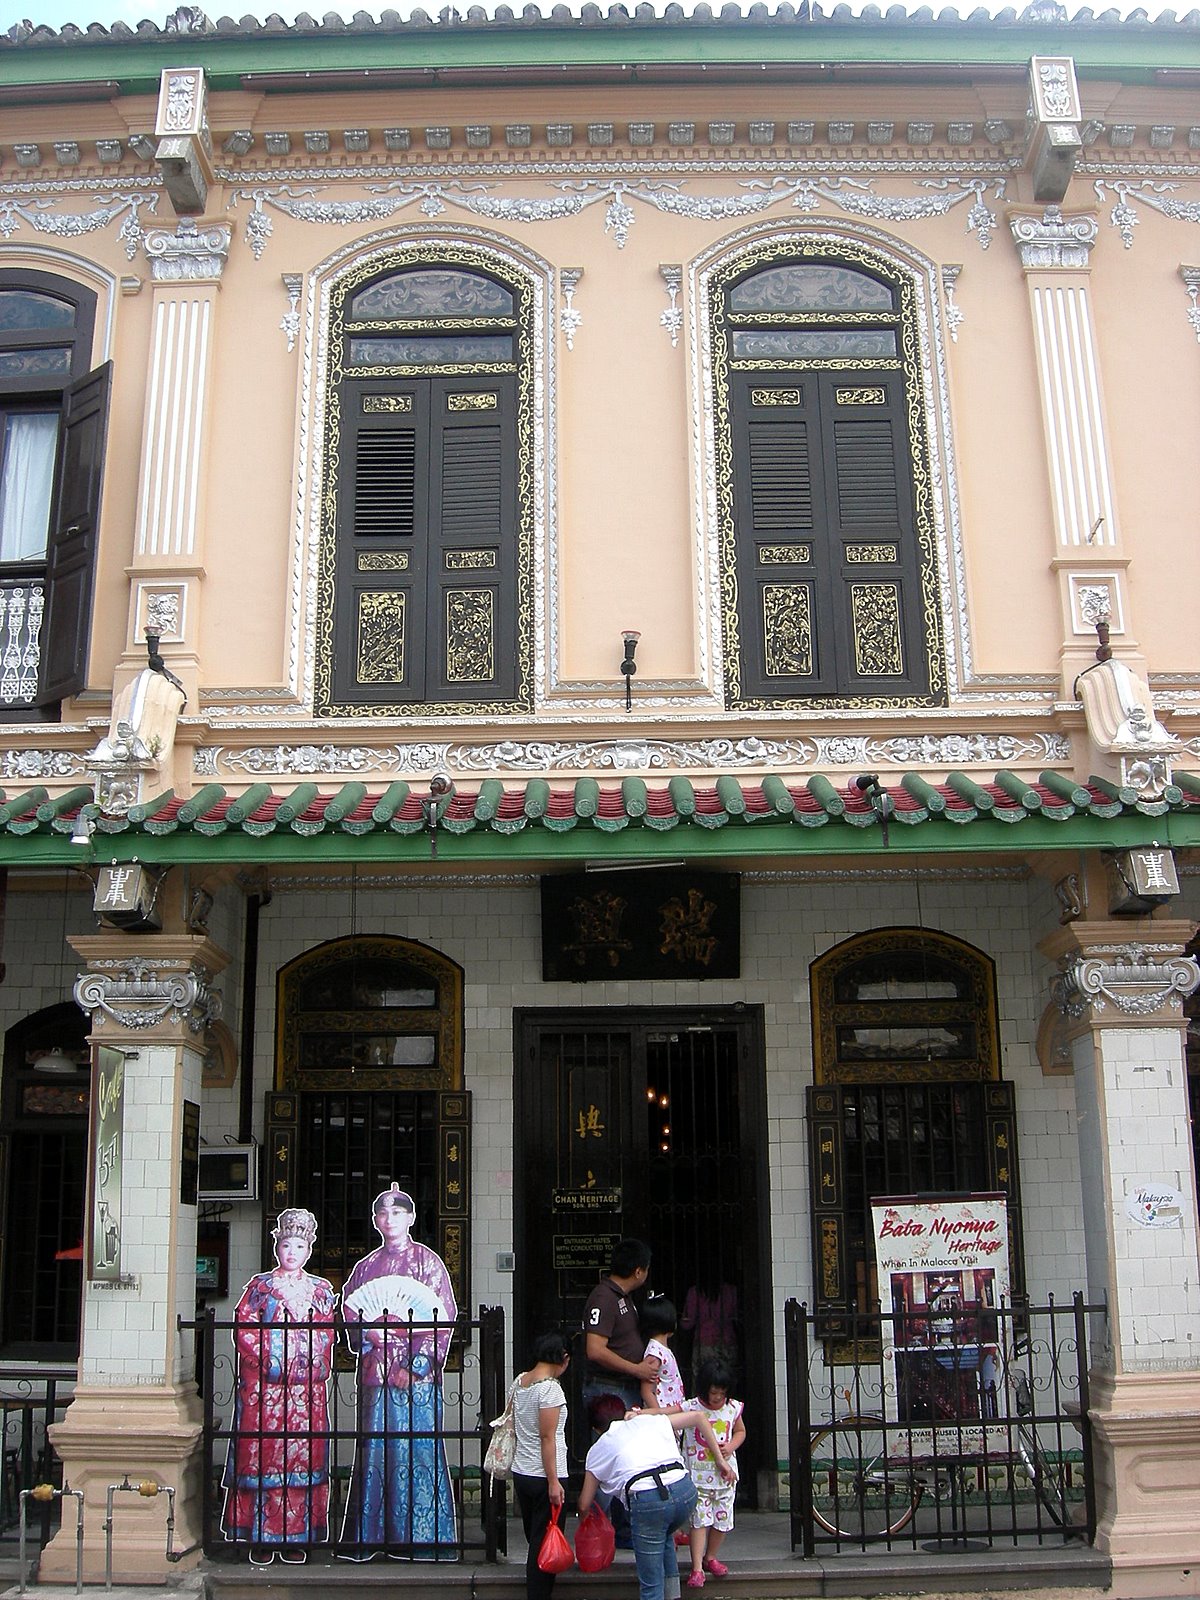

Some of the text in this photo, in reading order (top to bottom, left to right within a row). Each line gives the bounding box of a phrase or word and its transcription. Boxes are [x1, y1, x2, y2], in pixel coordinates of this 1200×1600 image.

[554, 1195, 619, 1204] CHAN HERITAGE
[879, 1216, 999, 1243] Baba Nyonya
[947, 1238, 1004, 1256] Heritage
[881, 1256, 979, 1268] When In Malacca Visit
[589, 1308, 601, 1325] 3
[965, 1428, 994, 1436] LOCAED
